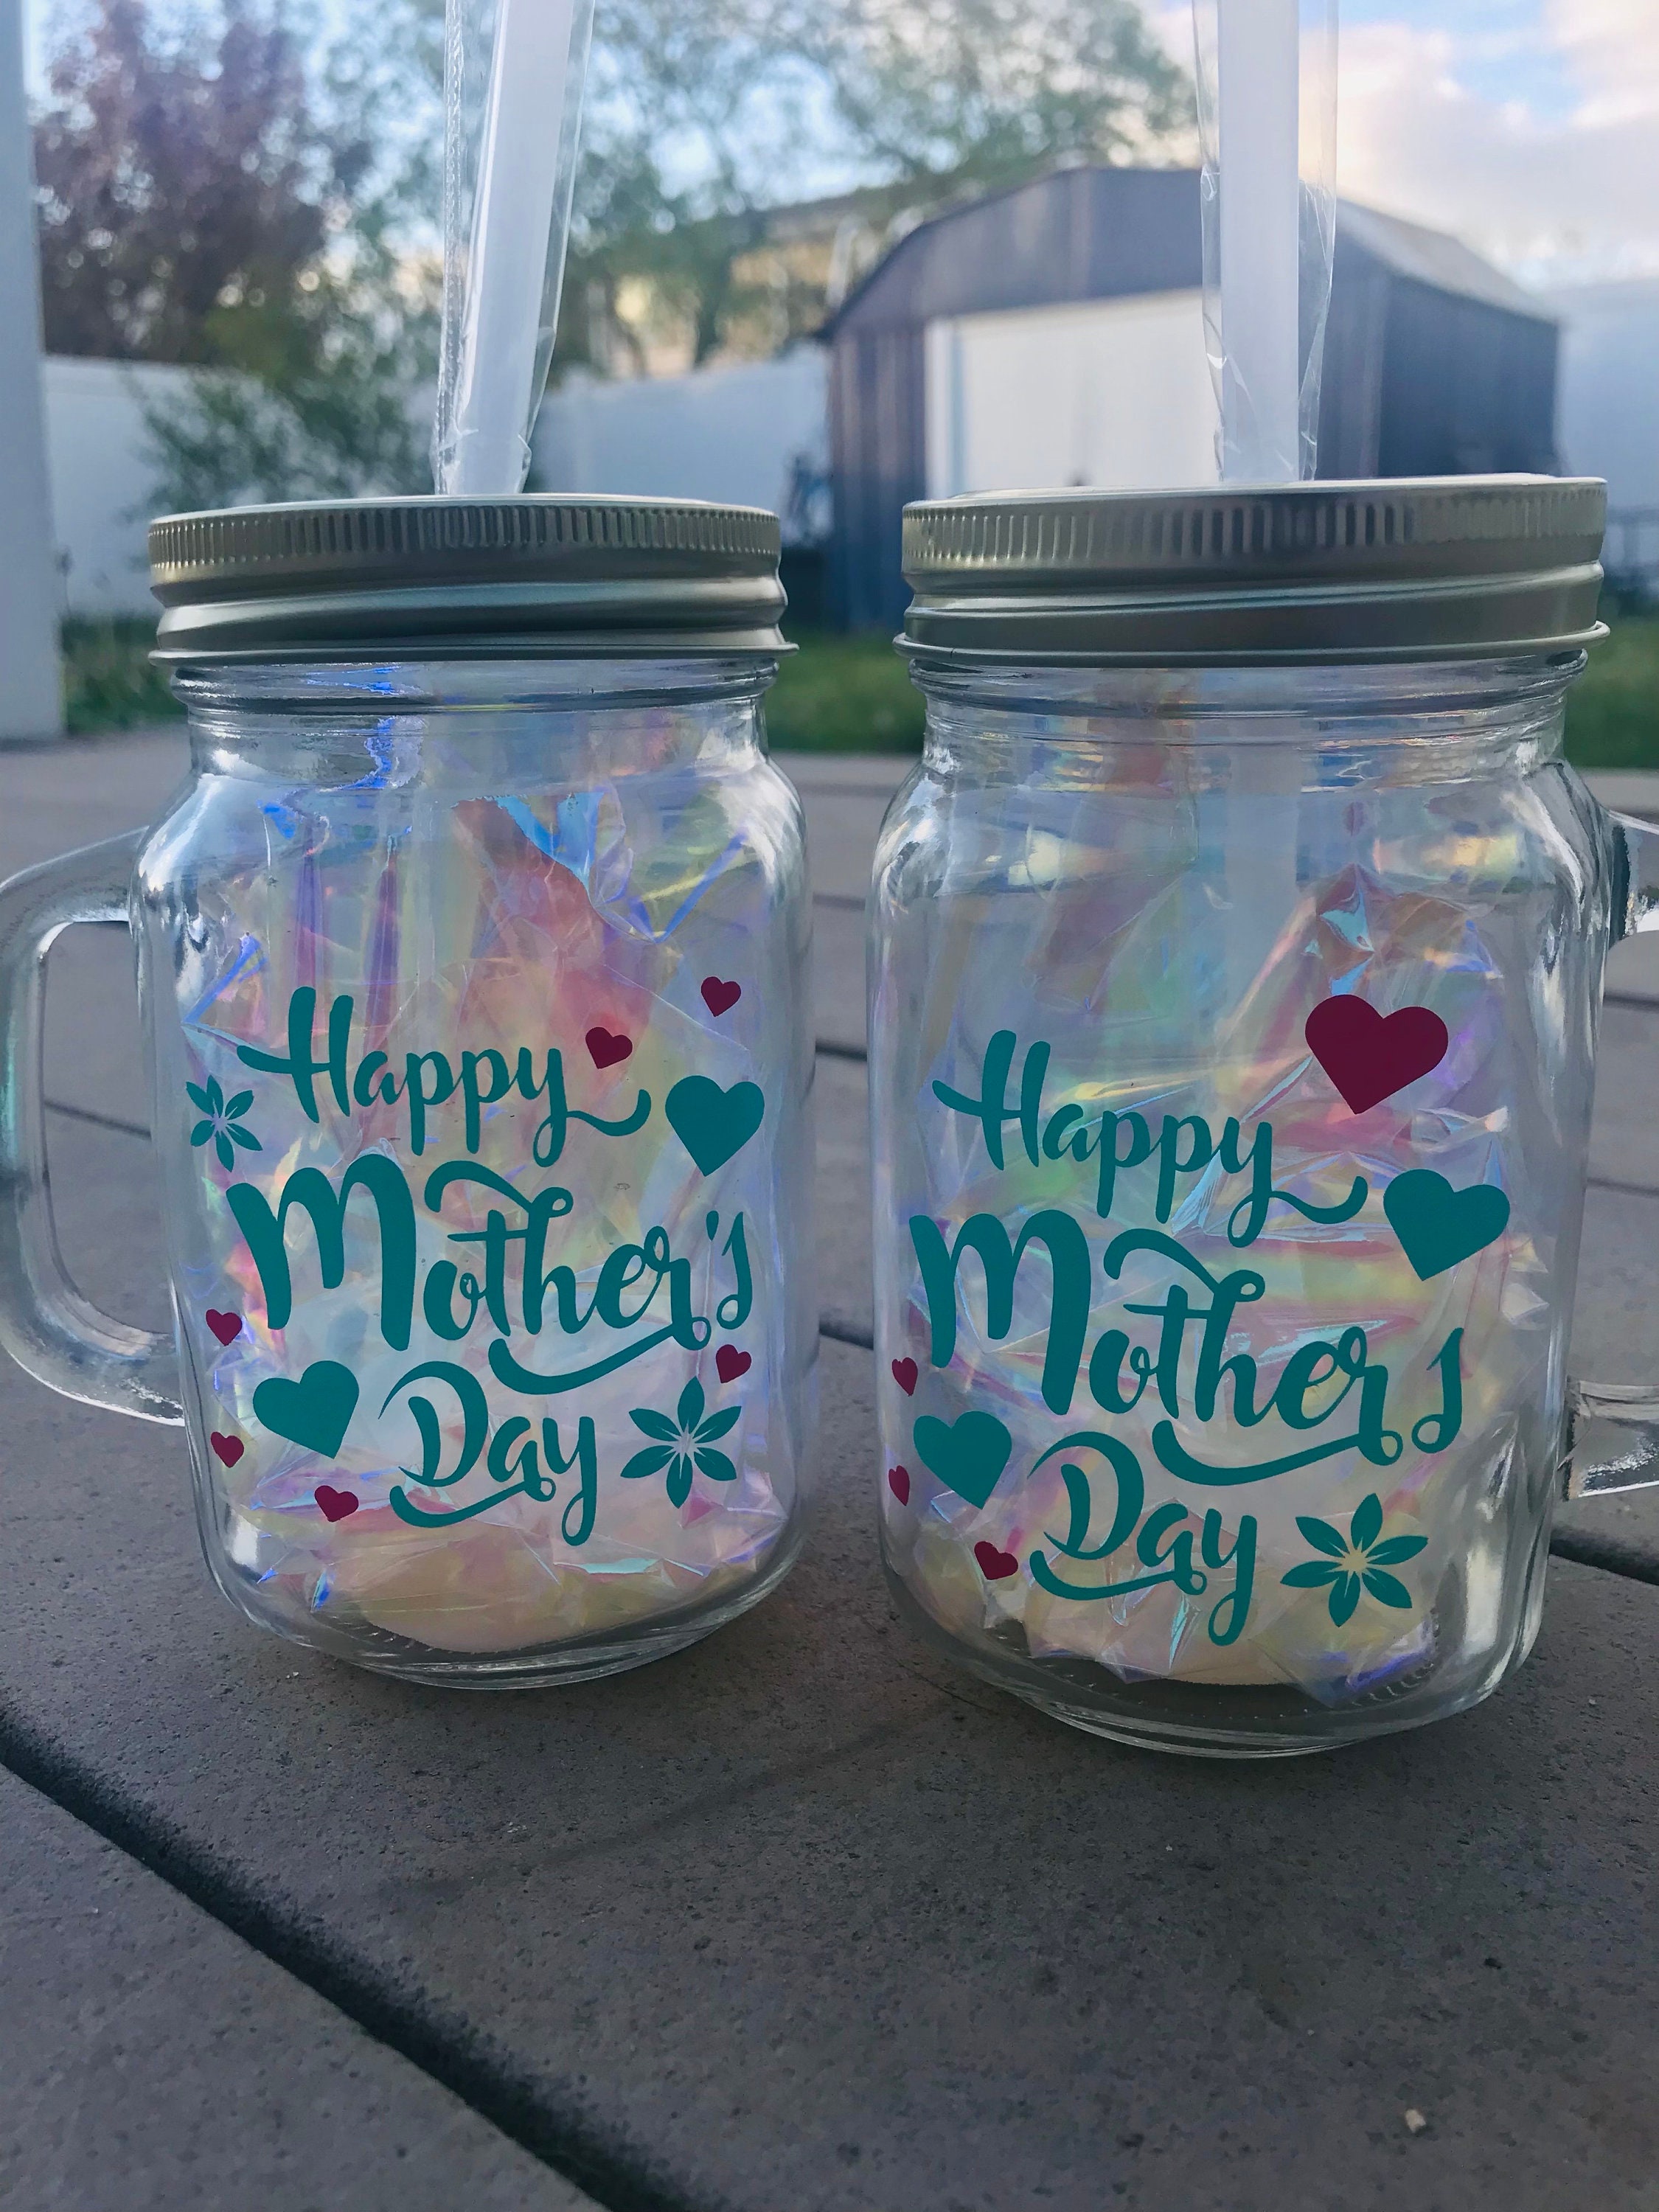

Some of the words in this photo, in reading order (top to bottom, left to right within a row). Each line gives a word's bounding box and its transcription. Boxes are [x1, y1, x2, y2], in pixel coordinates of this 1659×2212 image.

[237, 987, 652, 1167] Happy
[932, 1030, 1368, 1248] Happy
[226, 1153, 753, 1395] Mother's
[378, 1361, 597, 1546] Day
[1027, 1431, 1257, 1646] Day
